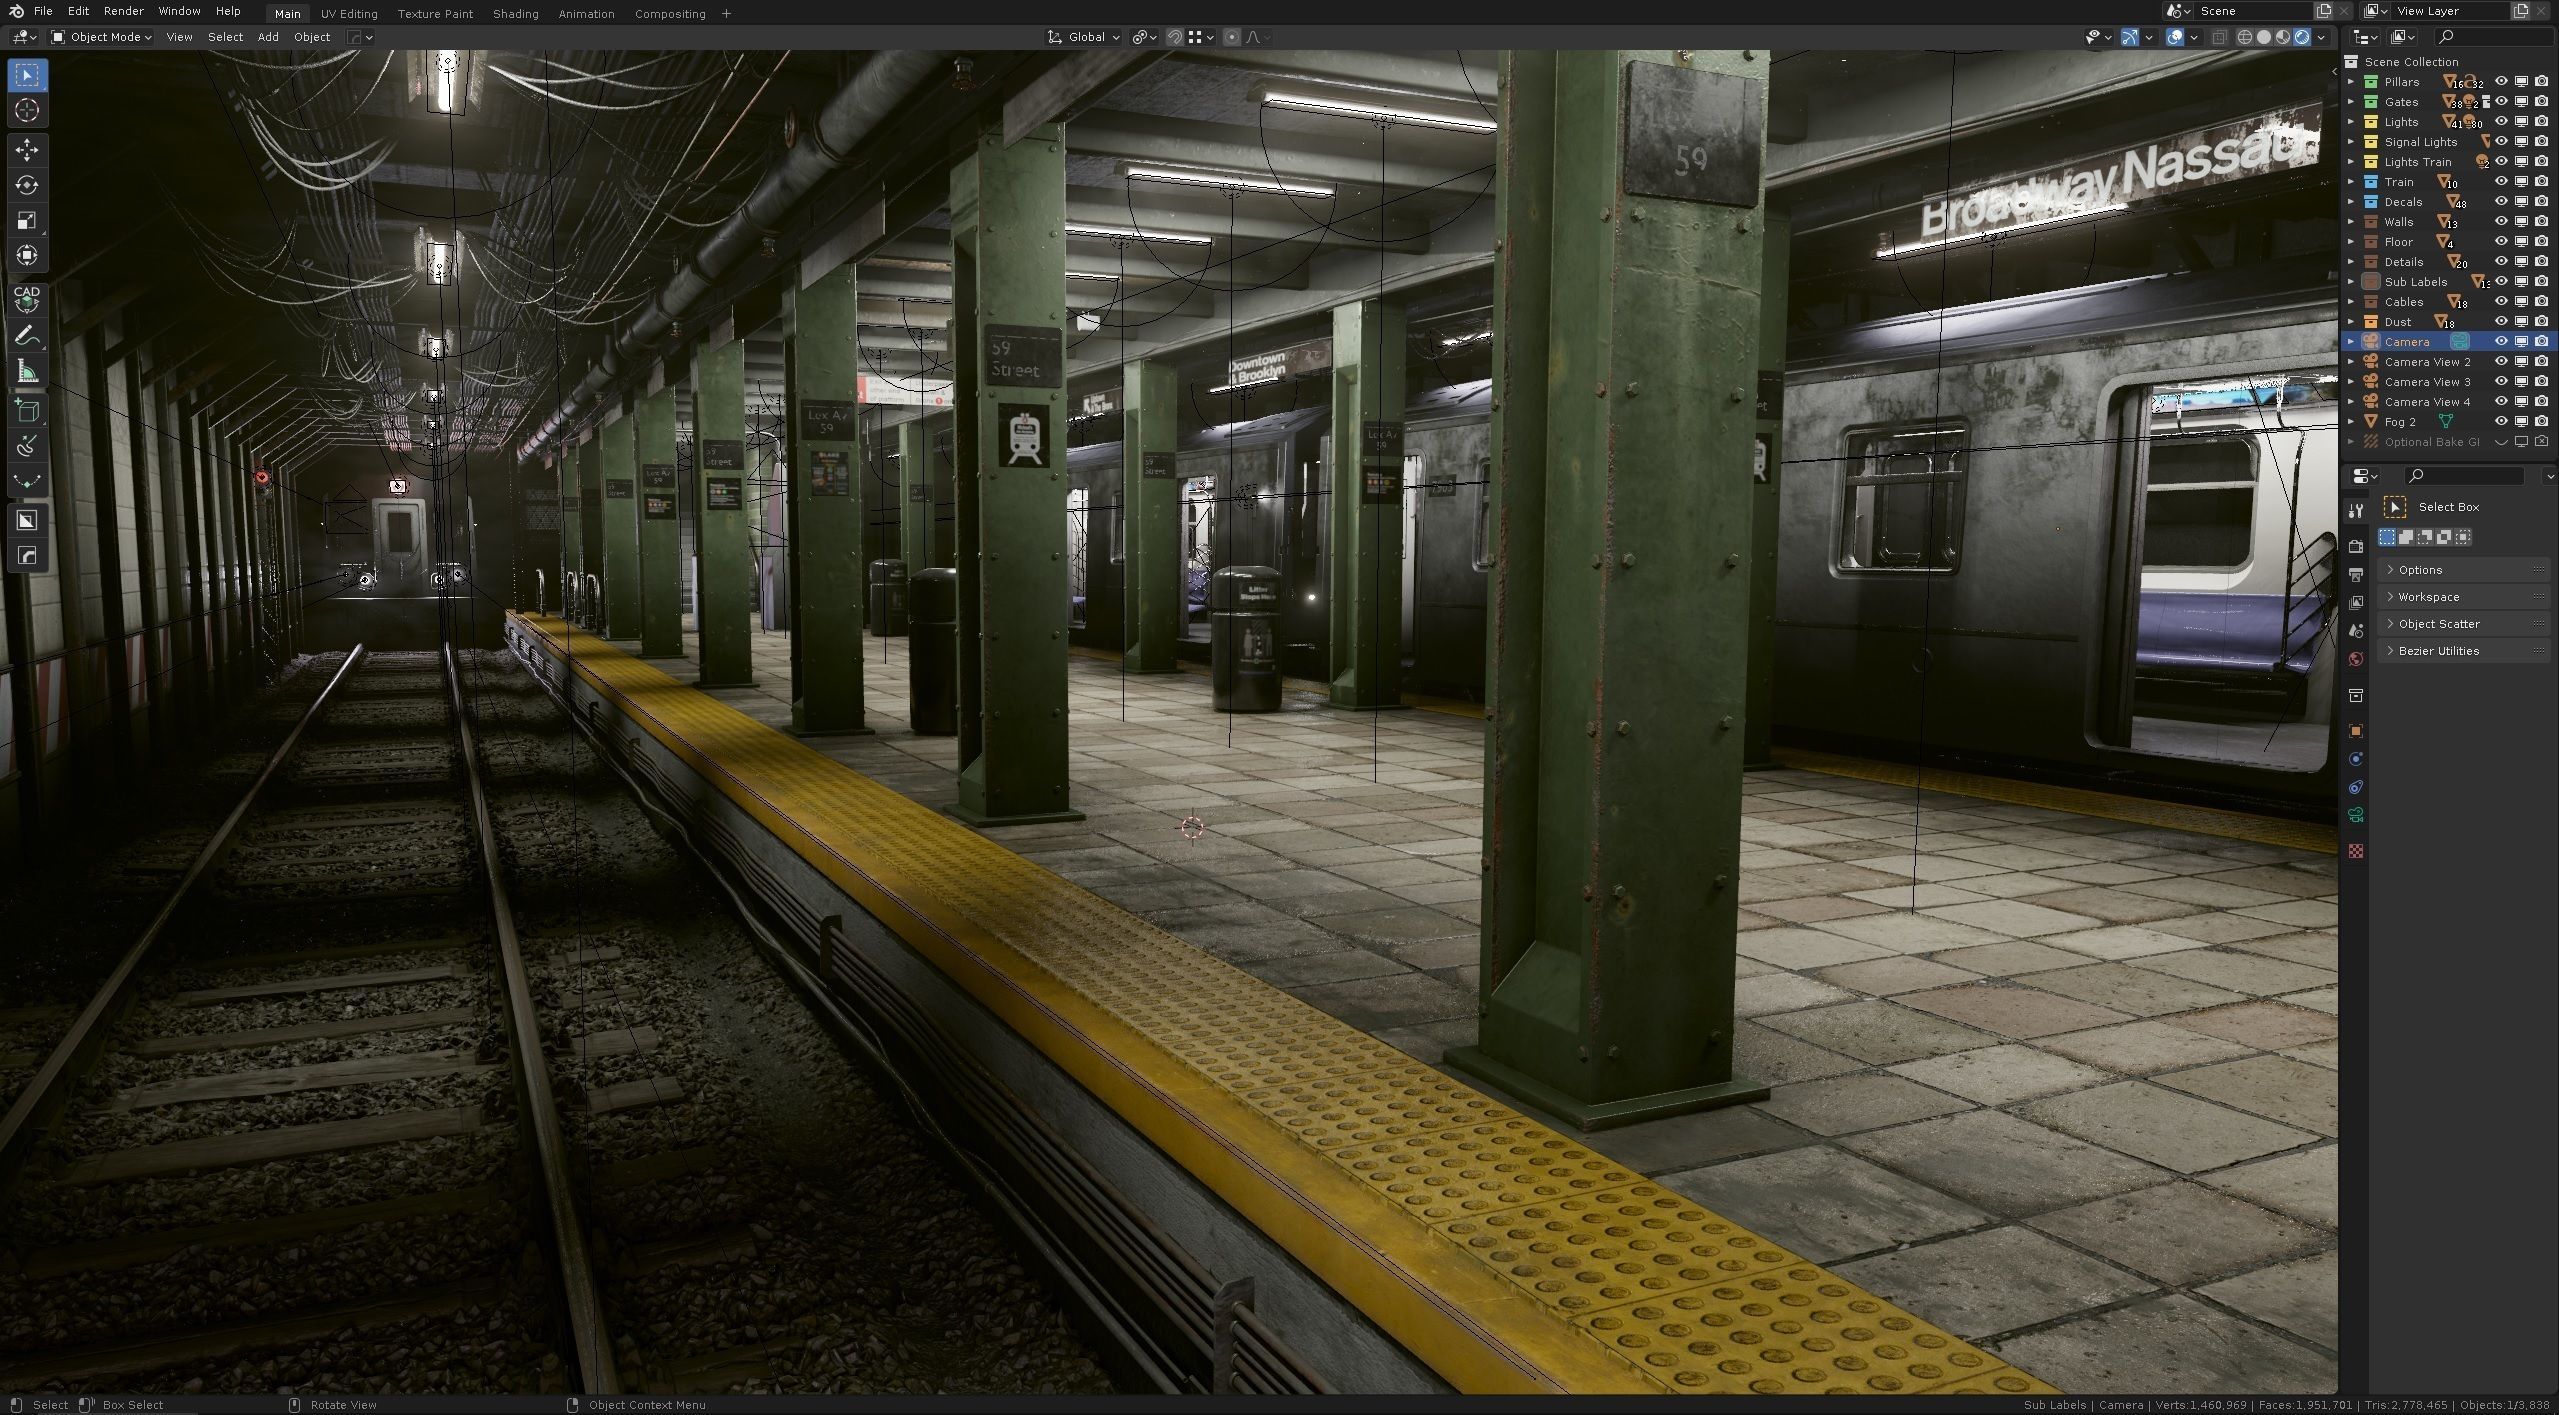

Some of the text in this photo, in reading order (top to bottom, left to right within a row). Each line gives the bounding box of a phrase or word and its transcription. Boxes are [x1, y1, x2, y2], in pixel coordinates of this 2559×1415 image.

[35, 6, 52, 15] File
[69, 6, 89, 15] Edit
[105, 6, 144, 15] Render
[159, 6, 200, 15] Window
[217, 6, 240, 17] Help
[276, 10, 300, 18] Main
[322, 9, 377, 20] UV Editing
[398, 10, 473, 18] Texture Paint
[494, 9, 538, 20] Shading
[559, 10, 614, 18] Animation
[636, 10, 705, 20] Compositing
[2202, 7, 2235, 15] Scene
[2398, 7, 2459, 17] View Layer
[72, 32, 140, 43] Object Mode
[167, 33, 192, 41] View
[209, 32, 243, 41] Select
[258, 32, 278, 41] Add
[295, 32, 330, 43] Object
[1070, 32, 1104, 41] Global
[2366, 57, 2458, 66] Scene Collection
[2386, 77, 2419, 86] Pillars
[2386, 98, 2418, 106] Gates
[2386, 117, 2418, 128] Lights
[2386, 137, 2457, 148] Signal Lights
[1674, 145, 1708, 177] 59
[2386, 157, 2451, 168] Lights Train
[2385, 178, 2413, 186] Train
[2386, 197, 2422, 206] Decals
[2385, 217, 2413, 226] Walls
[2386, 237, 2413, 246] Floor
[2386, 257, 2423, 266] Details
[2386, 277, 2447, 286] Sub Labels
[14, 286, 40, 297] CAD
[2386, 297, 2423, 306] Cables
[2386, 318, 2411, 326] Dust
[2386, 338, 2429, 346] Camera
[1228, 352, 1286, 373] Downtown
[2386, 358, 2470, 366] Camera View 2
[991, 360, 1041, 378] Street
[1238, 365, 1287, 382] Brooklyn
[2386, 378, 2470, 386] Camera View 3
[2386, 398, 2470, 406] Camera View 4
[2386, 418, 2415, 428] Fog 2
[2386, 437, 2431, 448] Optional
[2437, 437, 2463, 446] Bake
[2420, 502, 2479, 511] Select Box
[2400, 566, 2442, 576] Options
[2399, 592, 2459, 603] Workspace
[2400, 619, 2480, 630] Object Scatter
[2400, 646, 2479, 655] Bezier Utilities
[34, 1400, 68, 1409] Select
[104, 1400, 163, 1409] Box Select
[312, 1401, 376, 1409] Rotate View
[590, 1400, 705, 1411] Object Context Menu
[2025, 1400, 2549, 1411] Sub Labels Camera Verts:1,460,969 Faces:1,951,701 Tris:2,778,465 Objects:1/3,838
